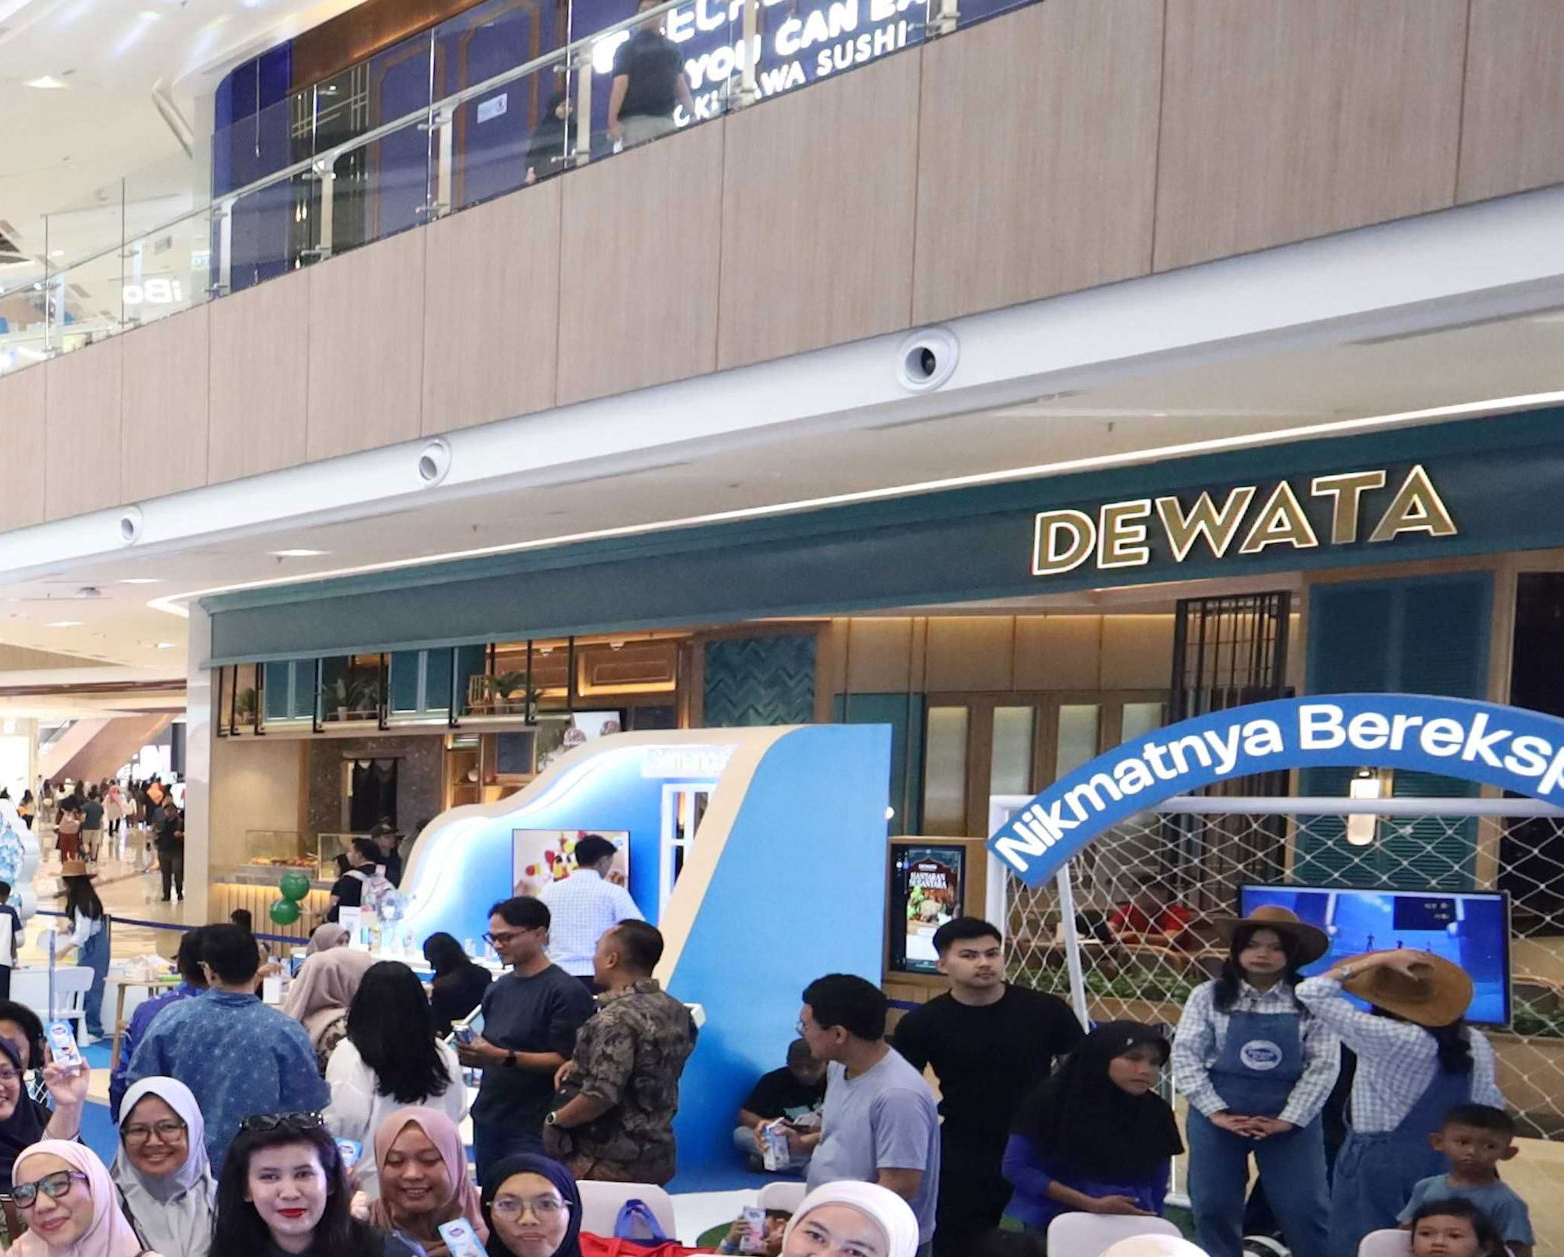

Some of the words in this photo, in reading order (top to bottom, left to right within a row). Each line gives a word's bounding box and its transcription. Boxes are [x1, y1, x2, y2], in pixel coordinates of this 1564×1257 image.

[684, 34, 761, 89] YOU
[775, 1, 858, 56] CAN
[816, 20, 907, 76] SUSHI
[1031, 465, 1458, 576] DEWATA
[995, 718, 1284, 872] Nikmatnya
